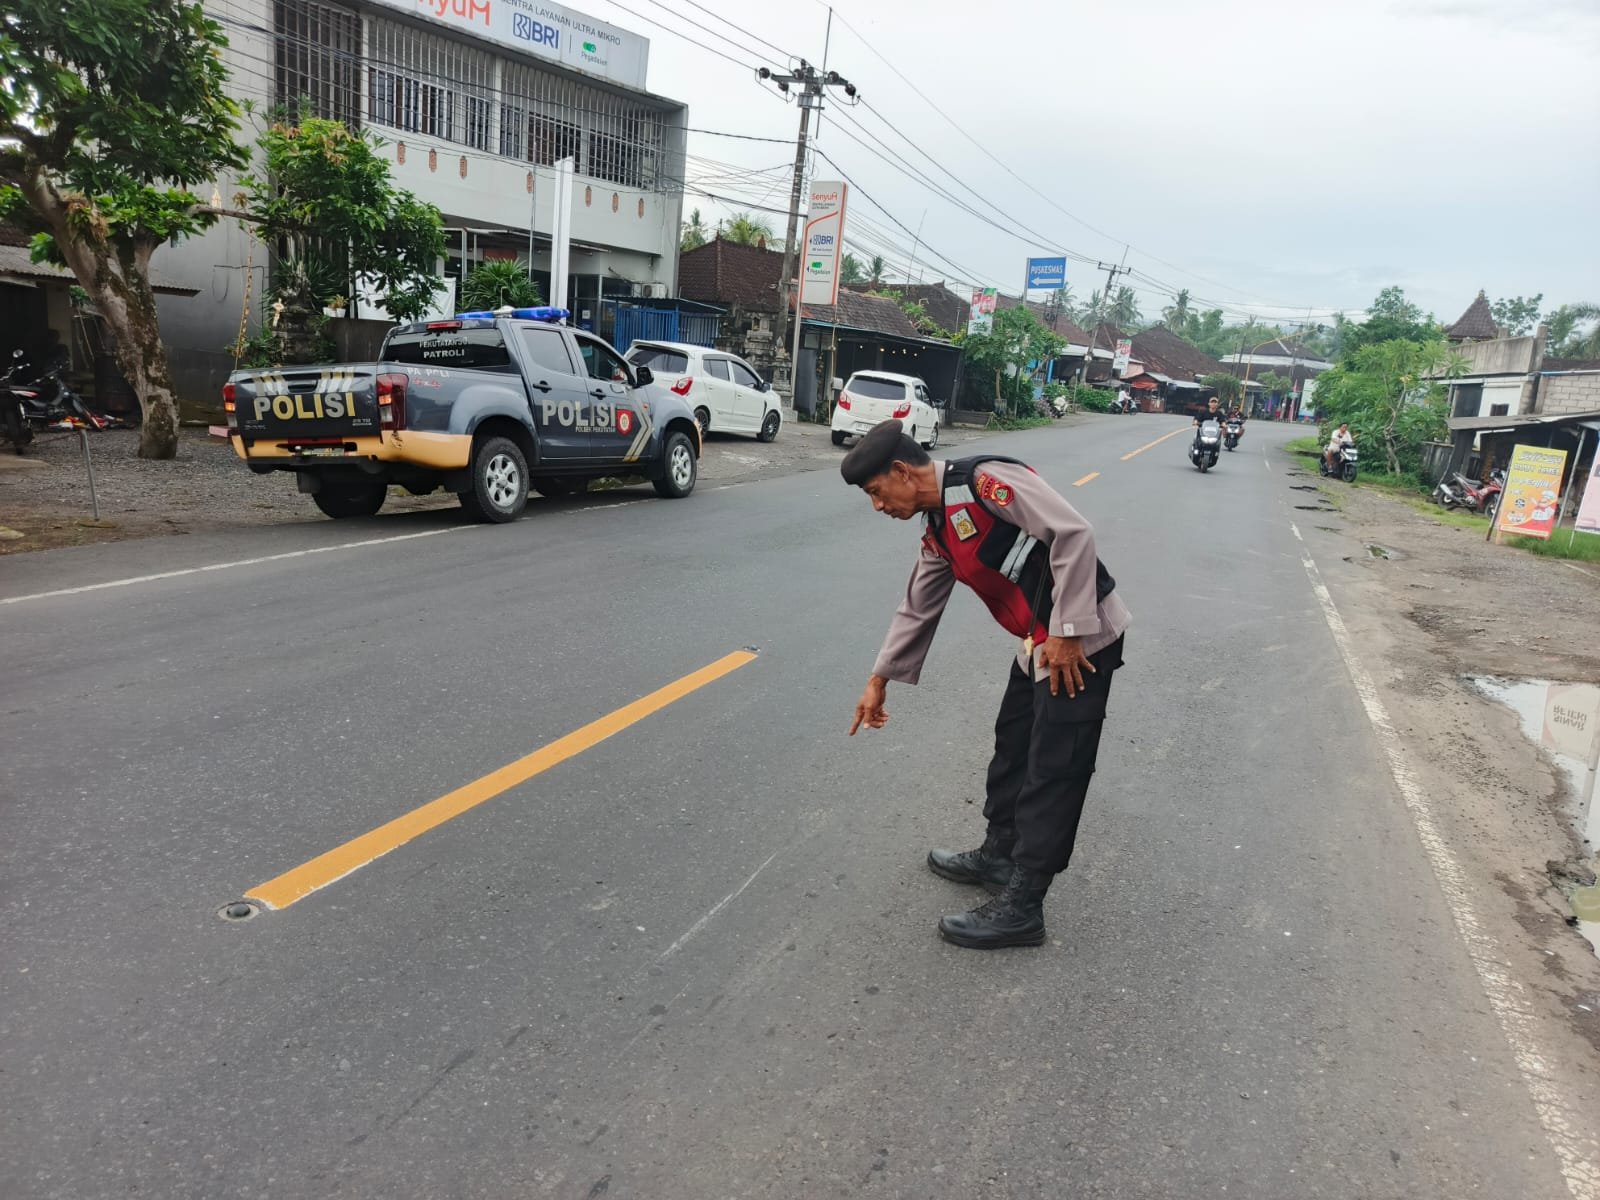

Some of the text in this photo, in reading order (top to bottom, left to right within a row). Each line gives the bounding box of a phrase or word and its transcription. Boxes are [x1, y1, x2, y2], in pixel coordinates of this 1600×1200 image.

[531, 20, 559, 49] BRI
[535, 5, 571, 28] LAYANAN
[573, 21, 596, 36] ULTRA
[597, 30, 621, 46] MIKRO
[821, 235, 833, 244] BRI
[1030, 264, 1063, 275] PUSKESMAS
[423, 348, 465, 359] PATROLI
[253, 392, 356, 420] POLISI
[542, 399, 615, 426] POLISI
